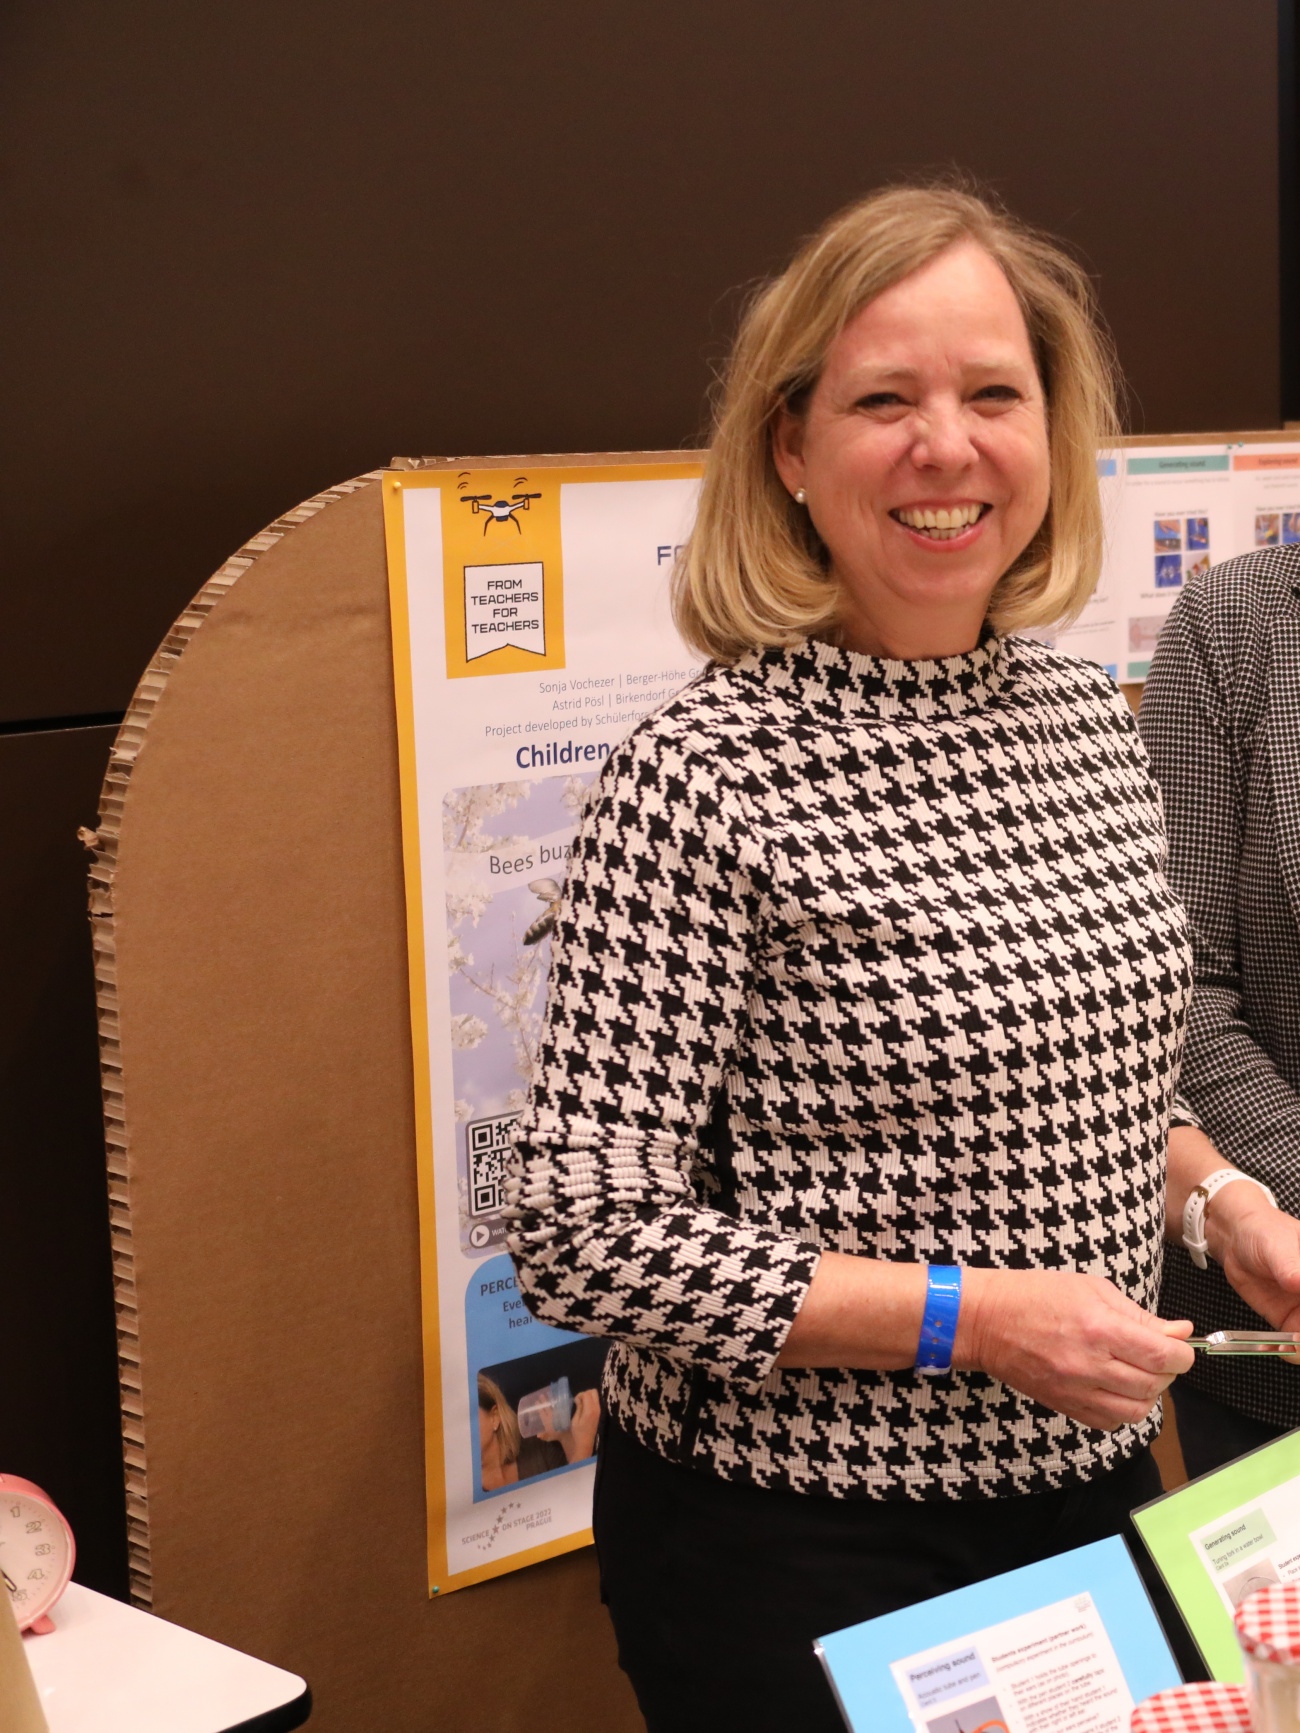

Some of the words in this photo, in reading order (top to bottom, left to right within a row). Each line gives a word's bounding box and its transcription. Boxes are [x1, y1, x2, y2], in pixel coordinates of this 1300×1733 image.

[487, 579, 522, 590] FROM
[470, 592, 539, 606] TEACHERS
[492, 607, 518, 618] FOR
[471, 620, 540, 634] TEACHERS
[540, 682, 567, 694] Sonja
[570, 678, 614, 690] Vochezer
[626, 670, 686, 685] Berger-Höhe
[552, 697, 582, 710] Astrid
[585, 696, 604, 708] Pösl
[616, 688, 666, 704] Birkendorf
[485, 724, 522, 738] Project
[525, 718, 578, 732] developed
[581, 717, 593, 728] by
[596, 710, 650, 725] Schülerfor
[516, 741, 610, 768] Children
[490, 855, 533, 875] Bees
[540, 846, 572, 864] buz
[462, 1530, 490, 1545] SCIENCE
[502, 1521, 512, 1531] ON
[513, 1513, 534, 1527] STAGE
[536, 1508, 552, 1520] 2022
[526, 1516, 552, 1531] PRAGUE
[1204, 1533, 1231, 1549] Generating
[1230, 1524, 1246, 1536] sound
[1212, 1554, 1227, 1564] Tuning
[910, 1663, 950, 1680] Perceiving
[952, 1652, 975, 1666] sound
